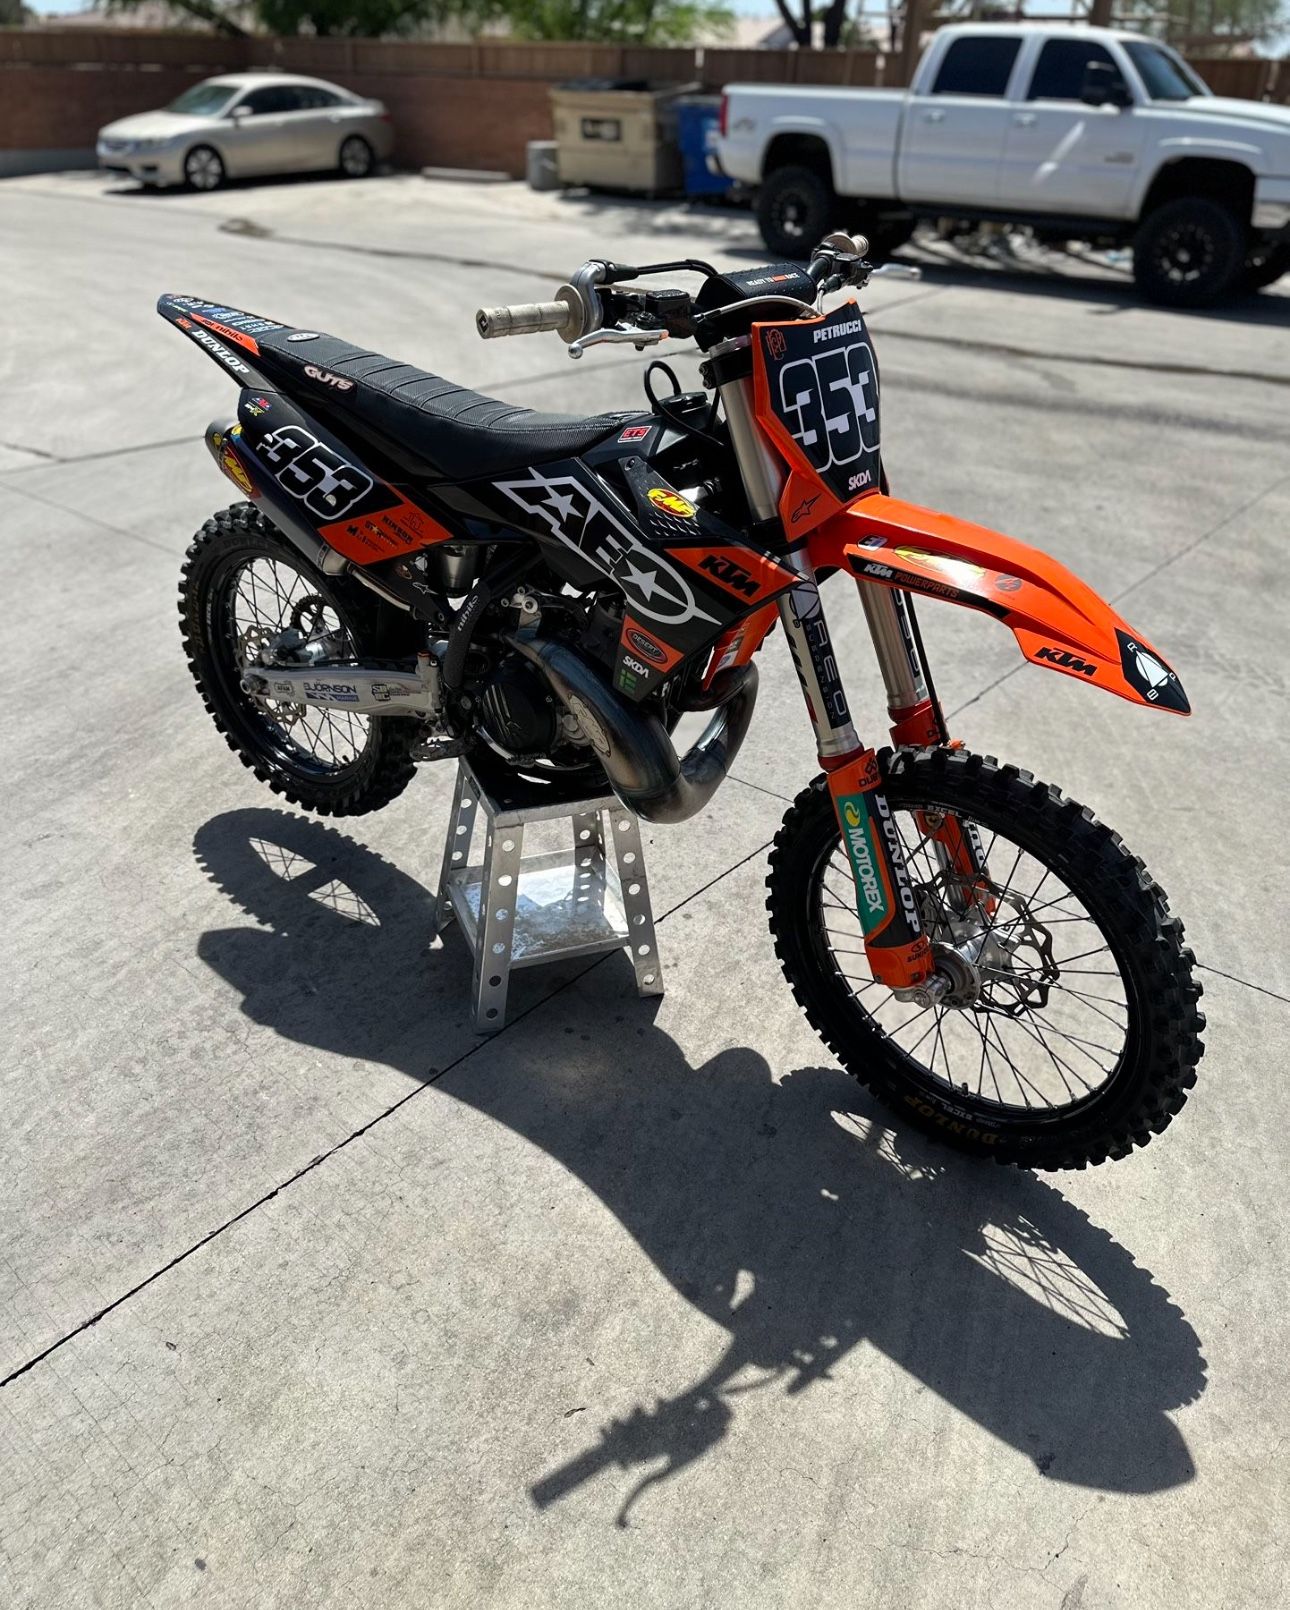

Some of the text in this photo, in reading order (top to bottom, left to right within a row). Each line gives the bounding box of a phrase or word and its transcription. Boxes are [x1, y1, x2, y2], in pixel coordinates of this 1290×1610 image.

[813, 319, 862, 343] PETRUCCI
[192, 329, 250, 373] DUNLOP
[304, 365, 354, 390] GUTS
[779, 342, 880, 474] 353
[256, 425, 374, 520] 353
[848, 469, 872, 490] SKDA
[647, 488, 697, 515] FMF
[698, 555, 762, 598] KTM
[864, 563, 960, 598] KTM POWERPARTS
[622, 655, 649, 679] SKDA
[1034, 647, 1098, 677] KTM
[848, 827, 885, 913] MOTOREX
[875, 794, 921, 934] DUNLOP
